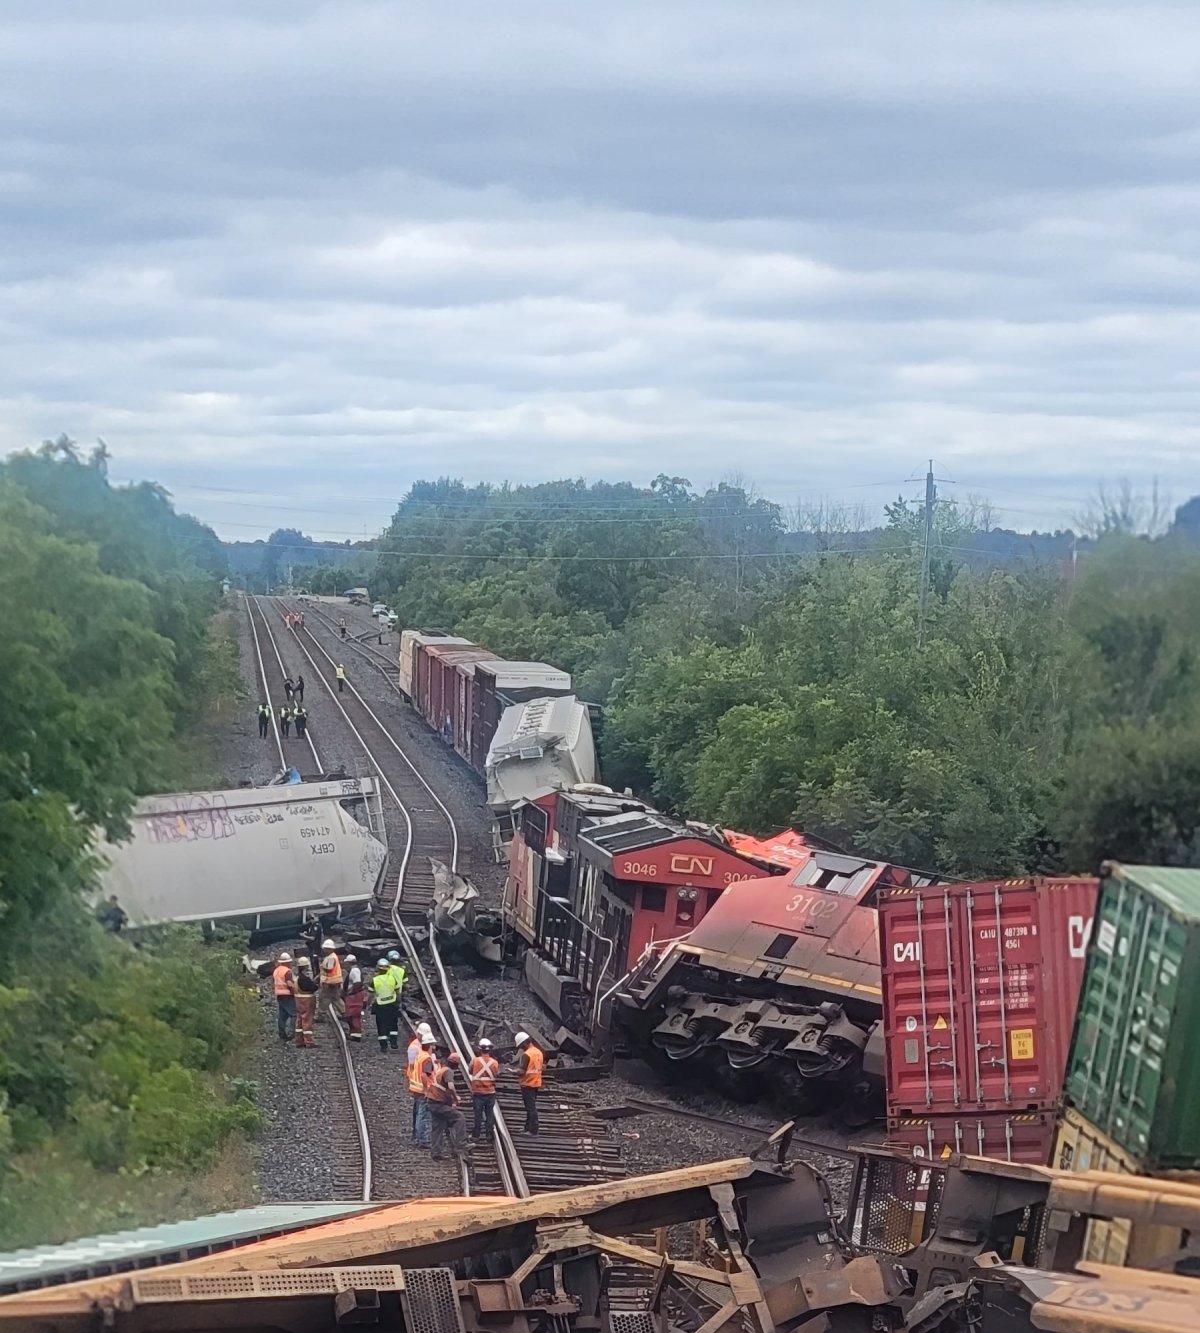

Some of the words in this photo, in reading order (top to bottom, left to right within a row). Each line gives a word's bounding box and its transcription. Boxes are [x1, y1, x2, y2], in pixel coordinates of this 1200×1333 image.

[301, 827, 330, 838] 471459
[311, 844, 335, 855] CBFX
[624, 862, 657, 877] 3046
[671, 856, 713, 875] CN
[786, 895, 839, 916] 3102
[980, 929, 995, 939] CAIU
[1006, 939, 1020, 948] 45G1
[894, 941, 921, 962] CAI
